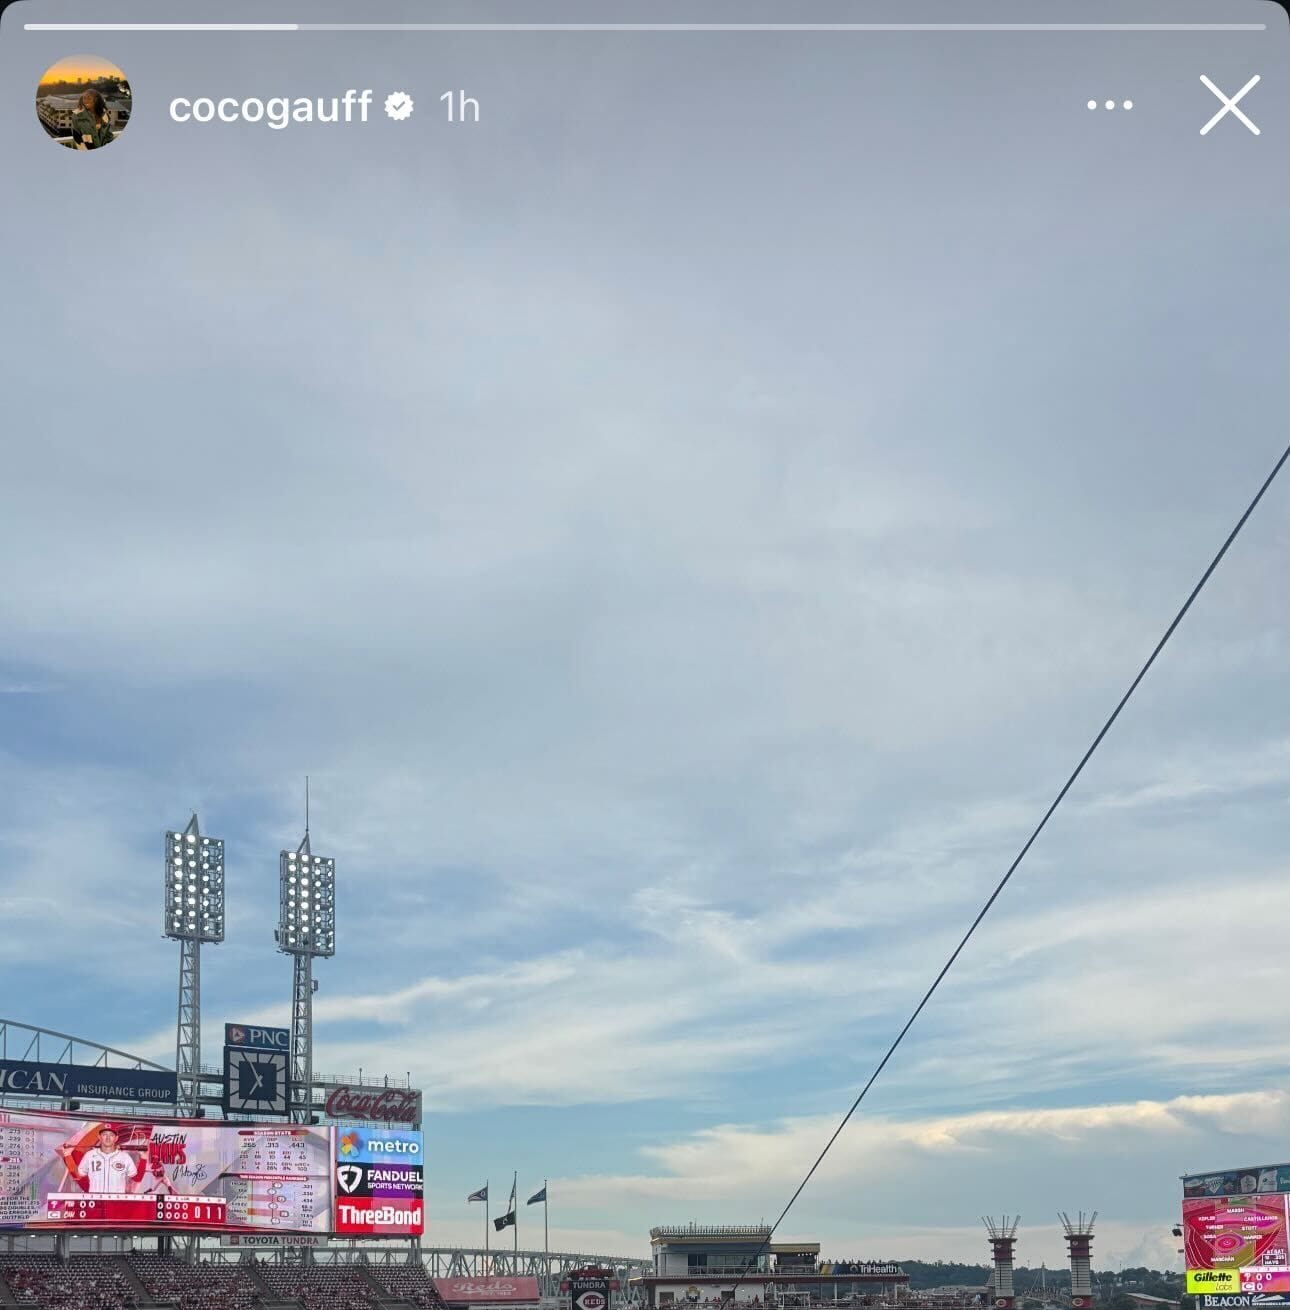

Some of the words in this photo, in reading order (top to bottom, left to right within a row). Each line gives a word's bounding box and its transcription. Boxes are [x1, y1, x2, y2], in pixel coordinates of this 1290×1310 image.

[249, 1028, 288, 1046] PNC
[77, 1084, 134, 1097] INSURANCE
[138, 1089, 171, 1099] GROUP
[151, 1133, 187, 1144] AUSTIN
[367, 1139, 419, 1154] metro
[367, 1170, 423, 1183] FANDUEL
[338, 1206, 422, 1225] ThreeBond
[243, 1237, 279, 1245] TOYOTA
[281, 1237, 319, 1245] TUNDRA
[859, 1264, 898, 1274] TriHealth
[1194, 1272, 1232, 1282] Gillette
[573, 1281, 606, 1289] TUNDRA
[1204, 1294, 1250, 1307] BEACON
